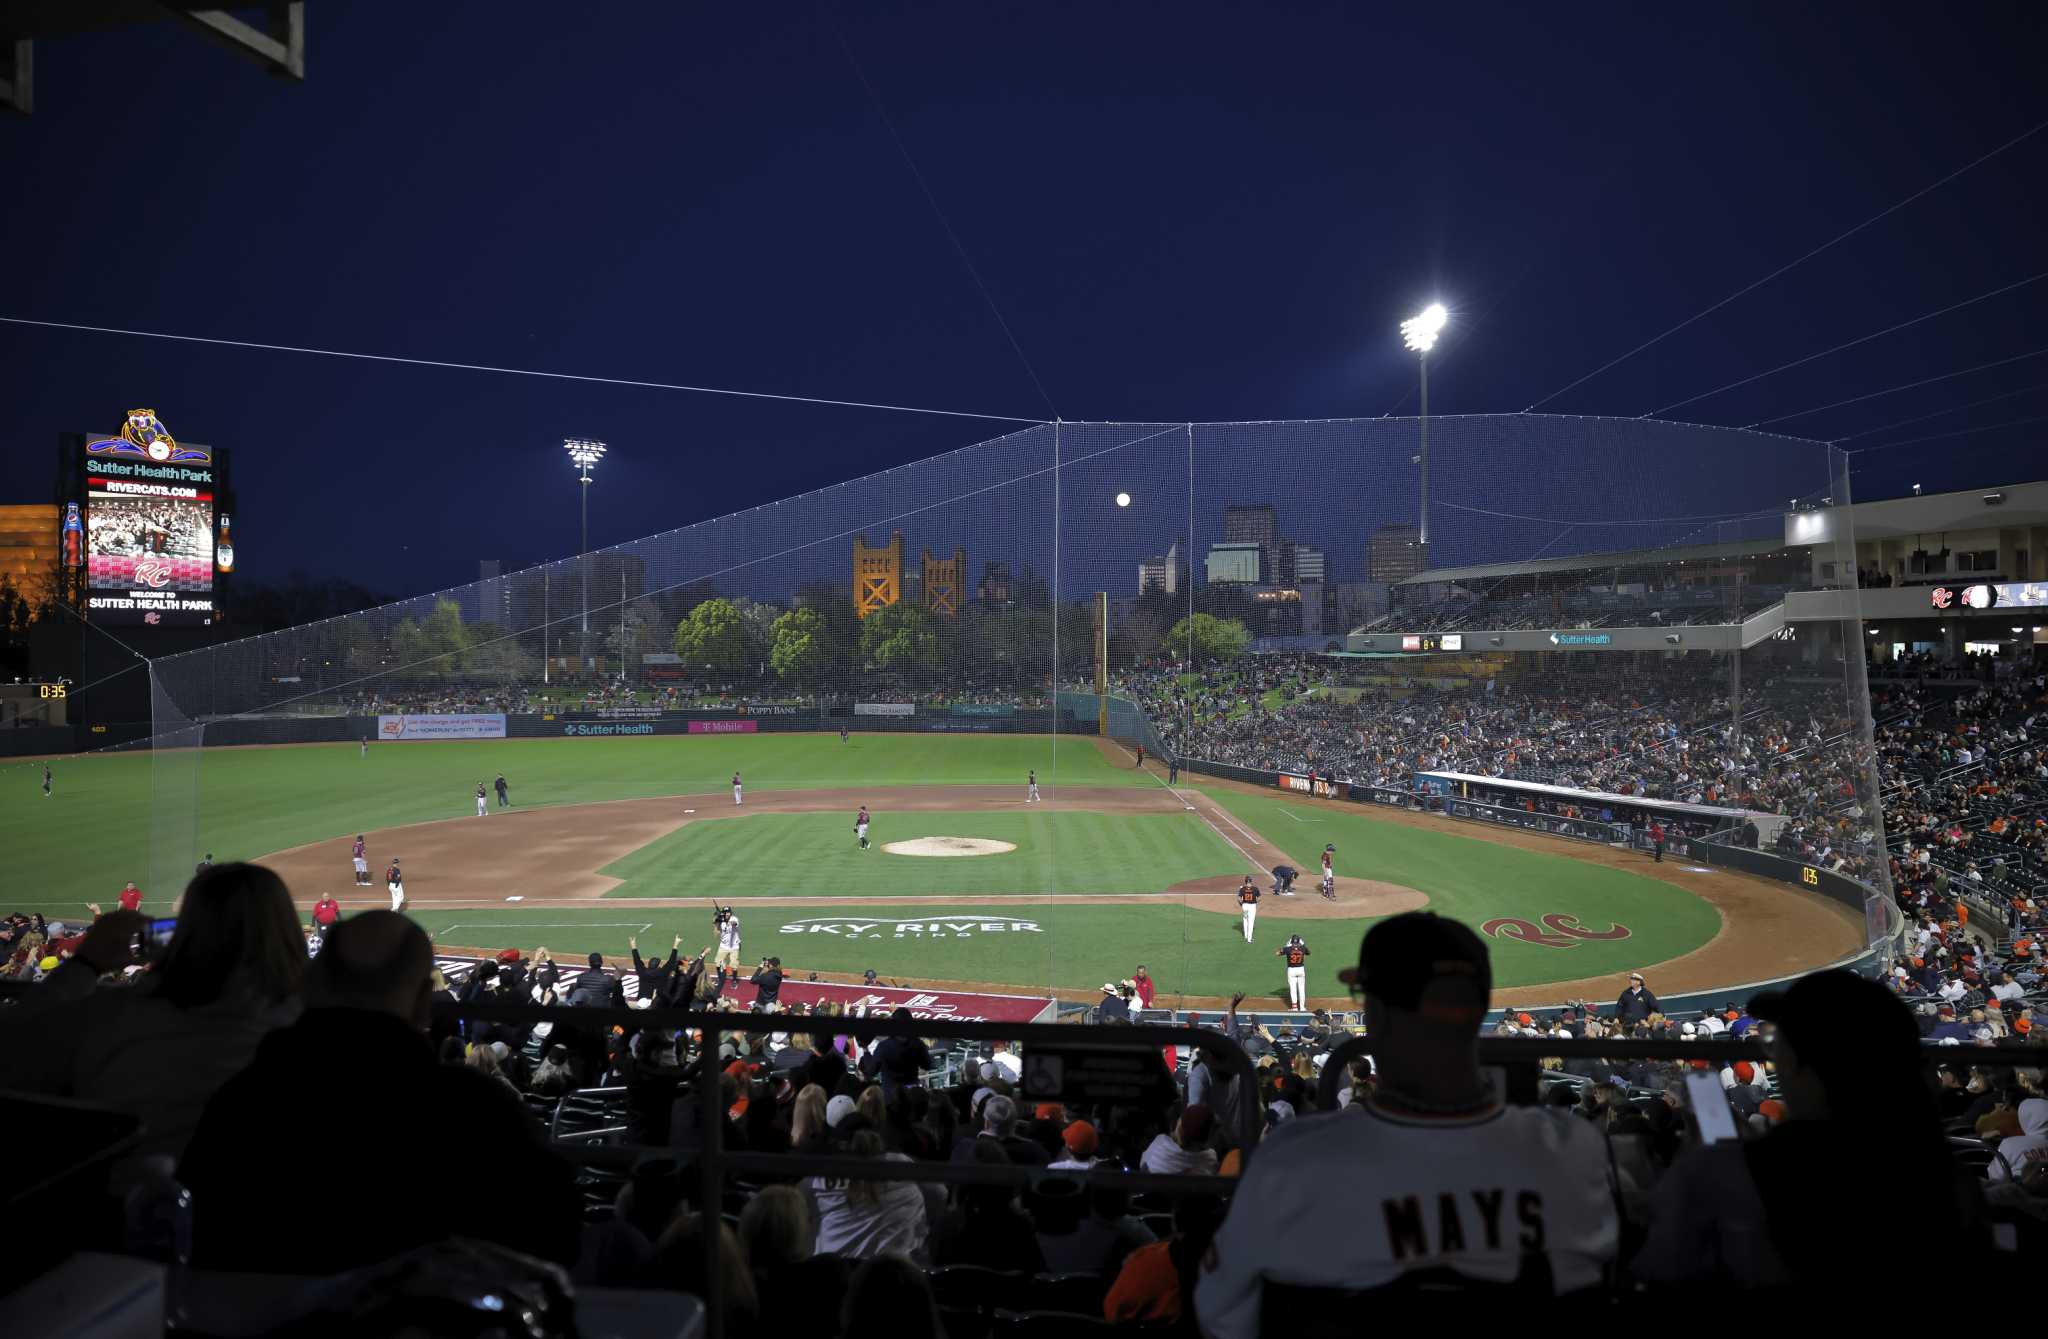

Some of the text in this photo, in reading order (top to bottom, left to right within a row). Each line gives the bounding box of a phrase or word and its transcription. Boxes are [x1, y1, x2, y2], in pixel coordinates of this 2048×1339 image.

[87, 459, 212, 482] Sutter Health Park
[107, 482, 196, 497] RIVERCATS.COM
[135, 560, 171, 588] RC
[89, 598, 212, 611] SUTTER HEALTH PARK
[1560, 633, 1610, 644] Sutter Health
[40, 685, 66, 698] 0:35
[578, 724, 653, 735] Sutter Health
[779, 922, 1046, 934] SKY RIVER
[1382, 1190, 1545, 1261] MAYS
